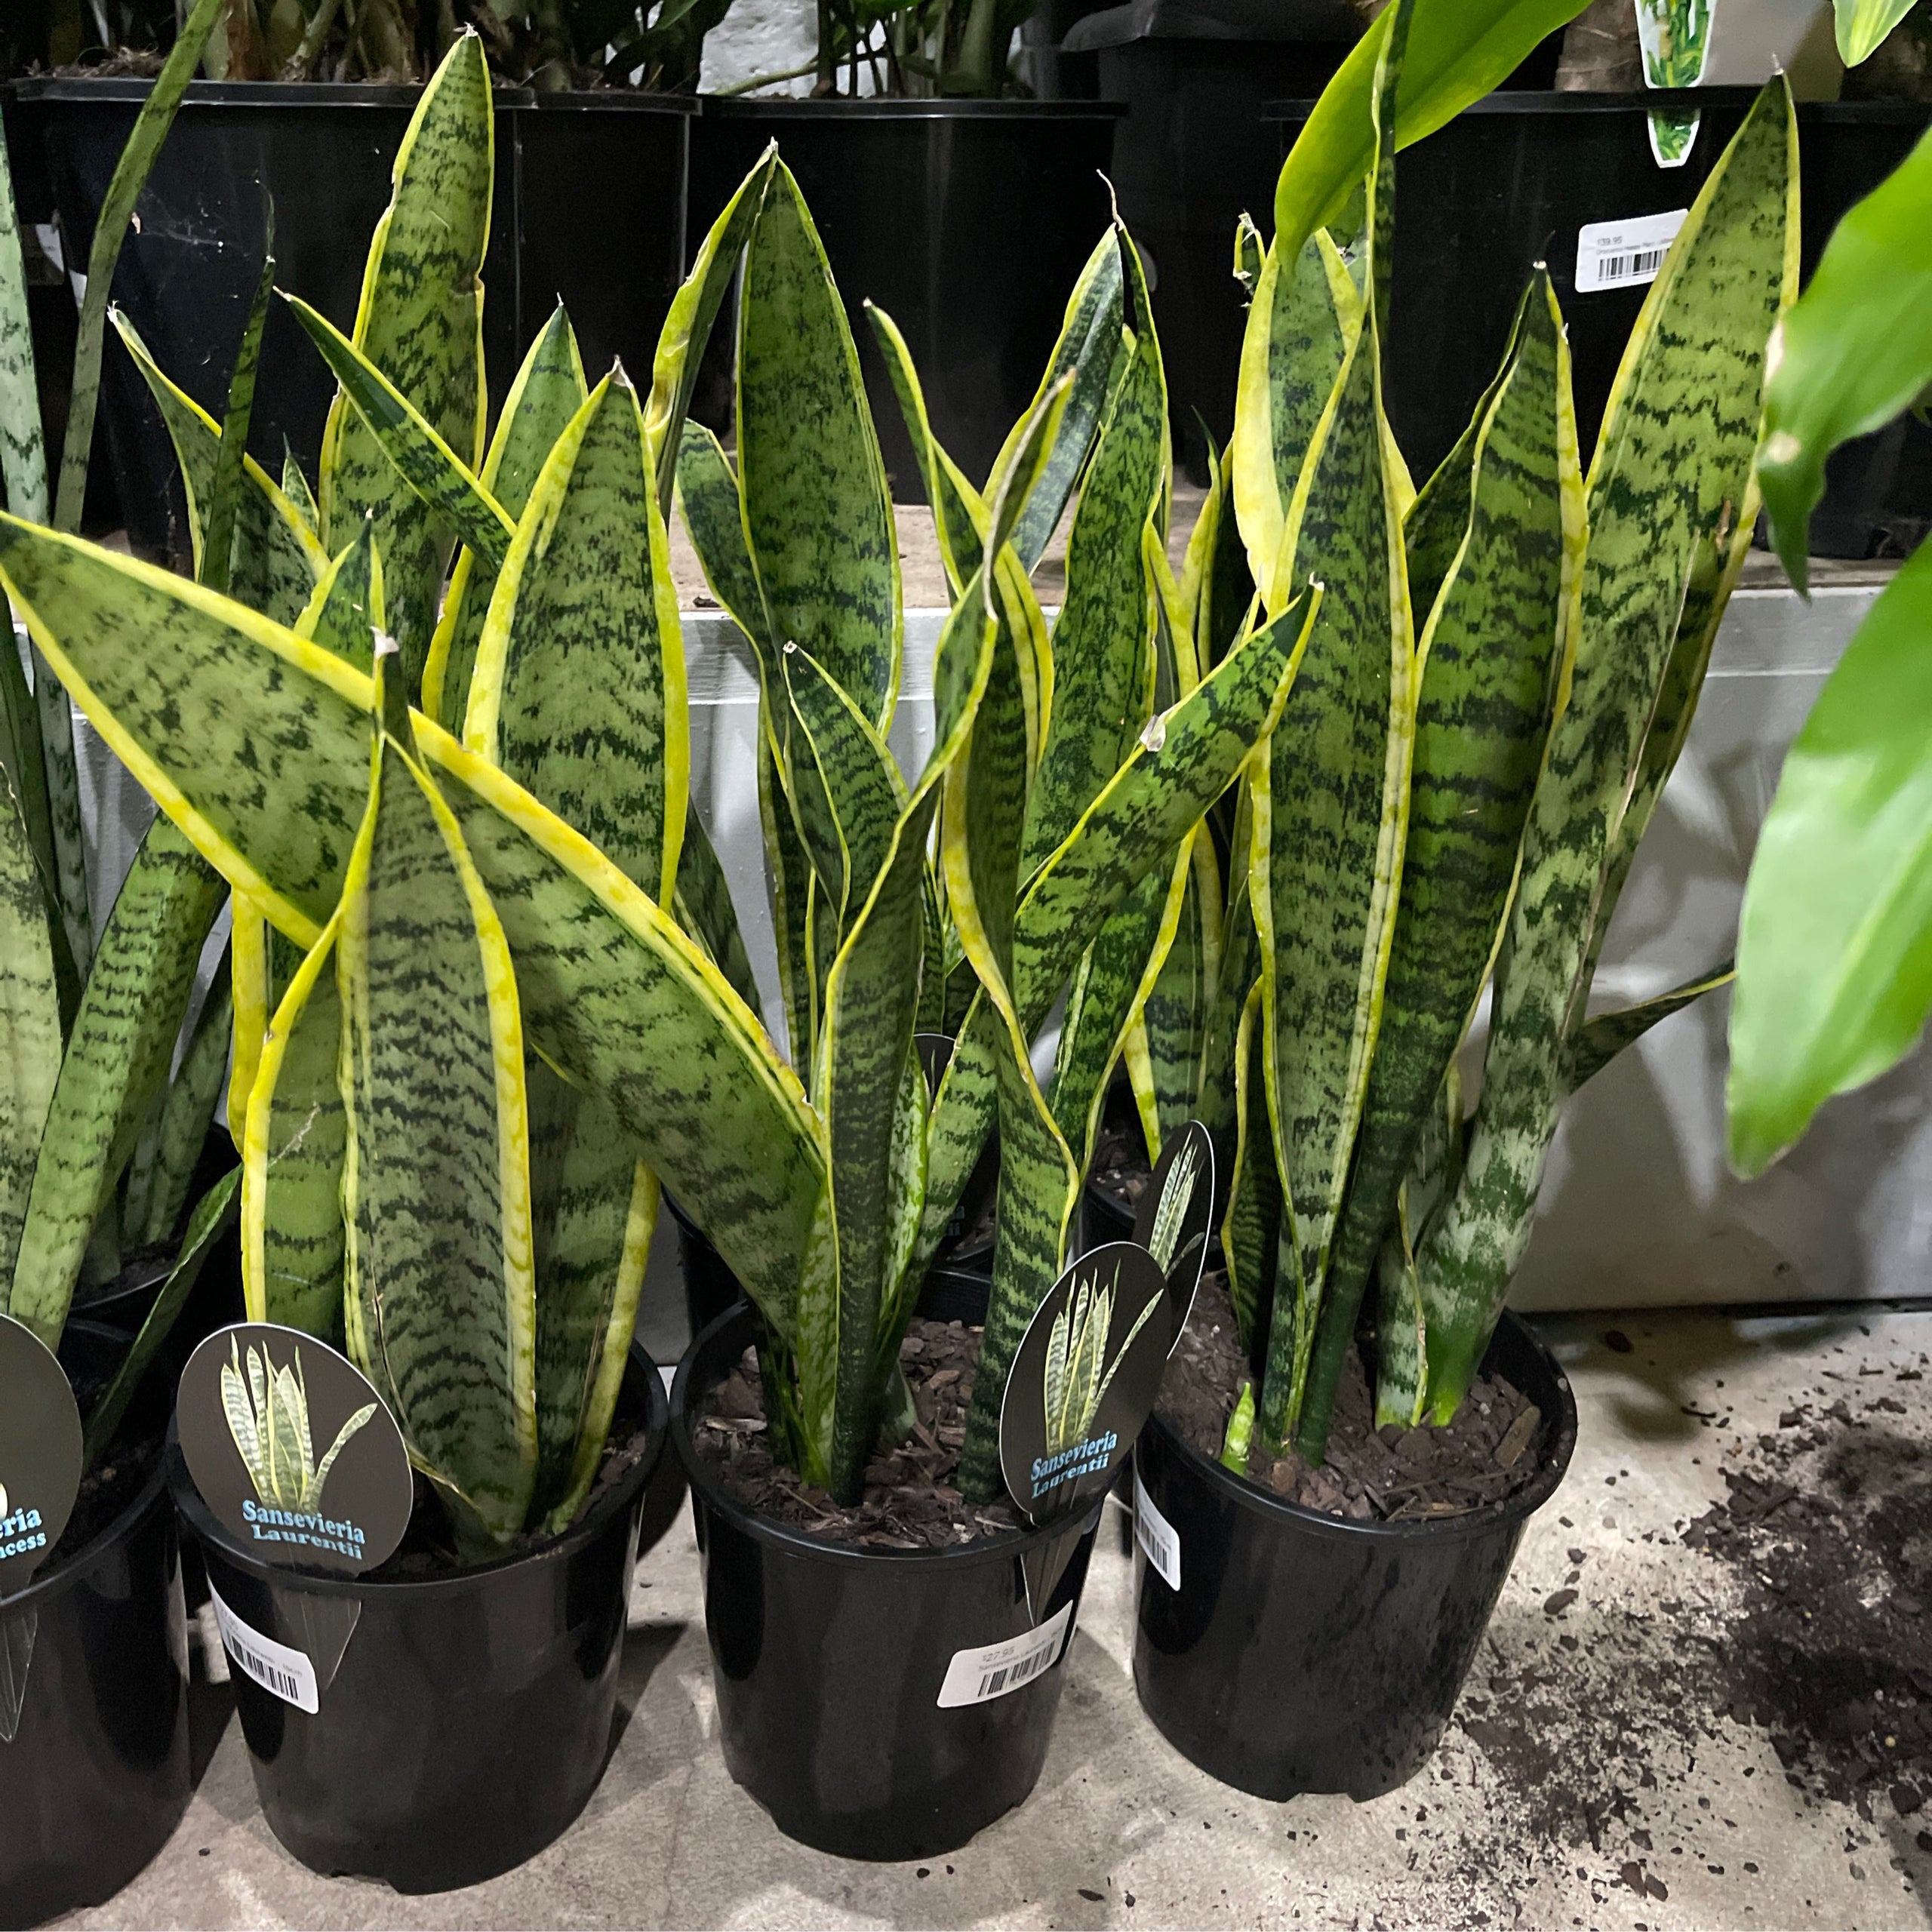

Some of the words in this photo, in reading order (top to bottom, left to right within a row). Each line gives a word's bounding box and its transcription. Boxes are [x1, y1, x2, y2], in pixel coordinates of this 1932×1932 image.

[1030, 1429, 1118, 1481] Sansevieria
[1031, 1452, 1109, 1500] Laurentii
[0, 1507, 42, 1540] ria
[242, 1499, 365, 1545] Sansevieria
[251, 1524, 362, 1560] Laurentii
